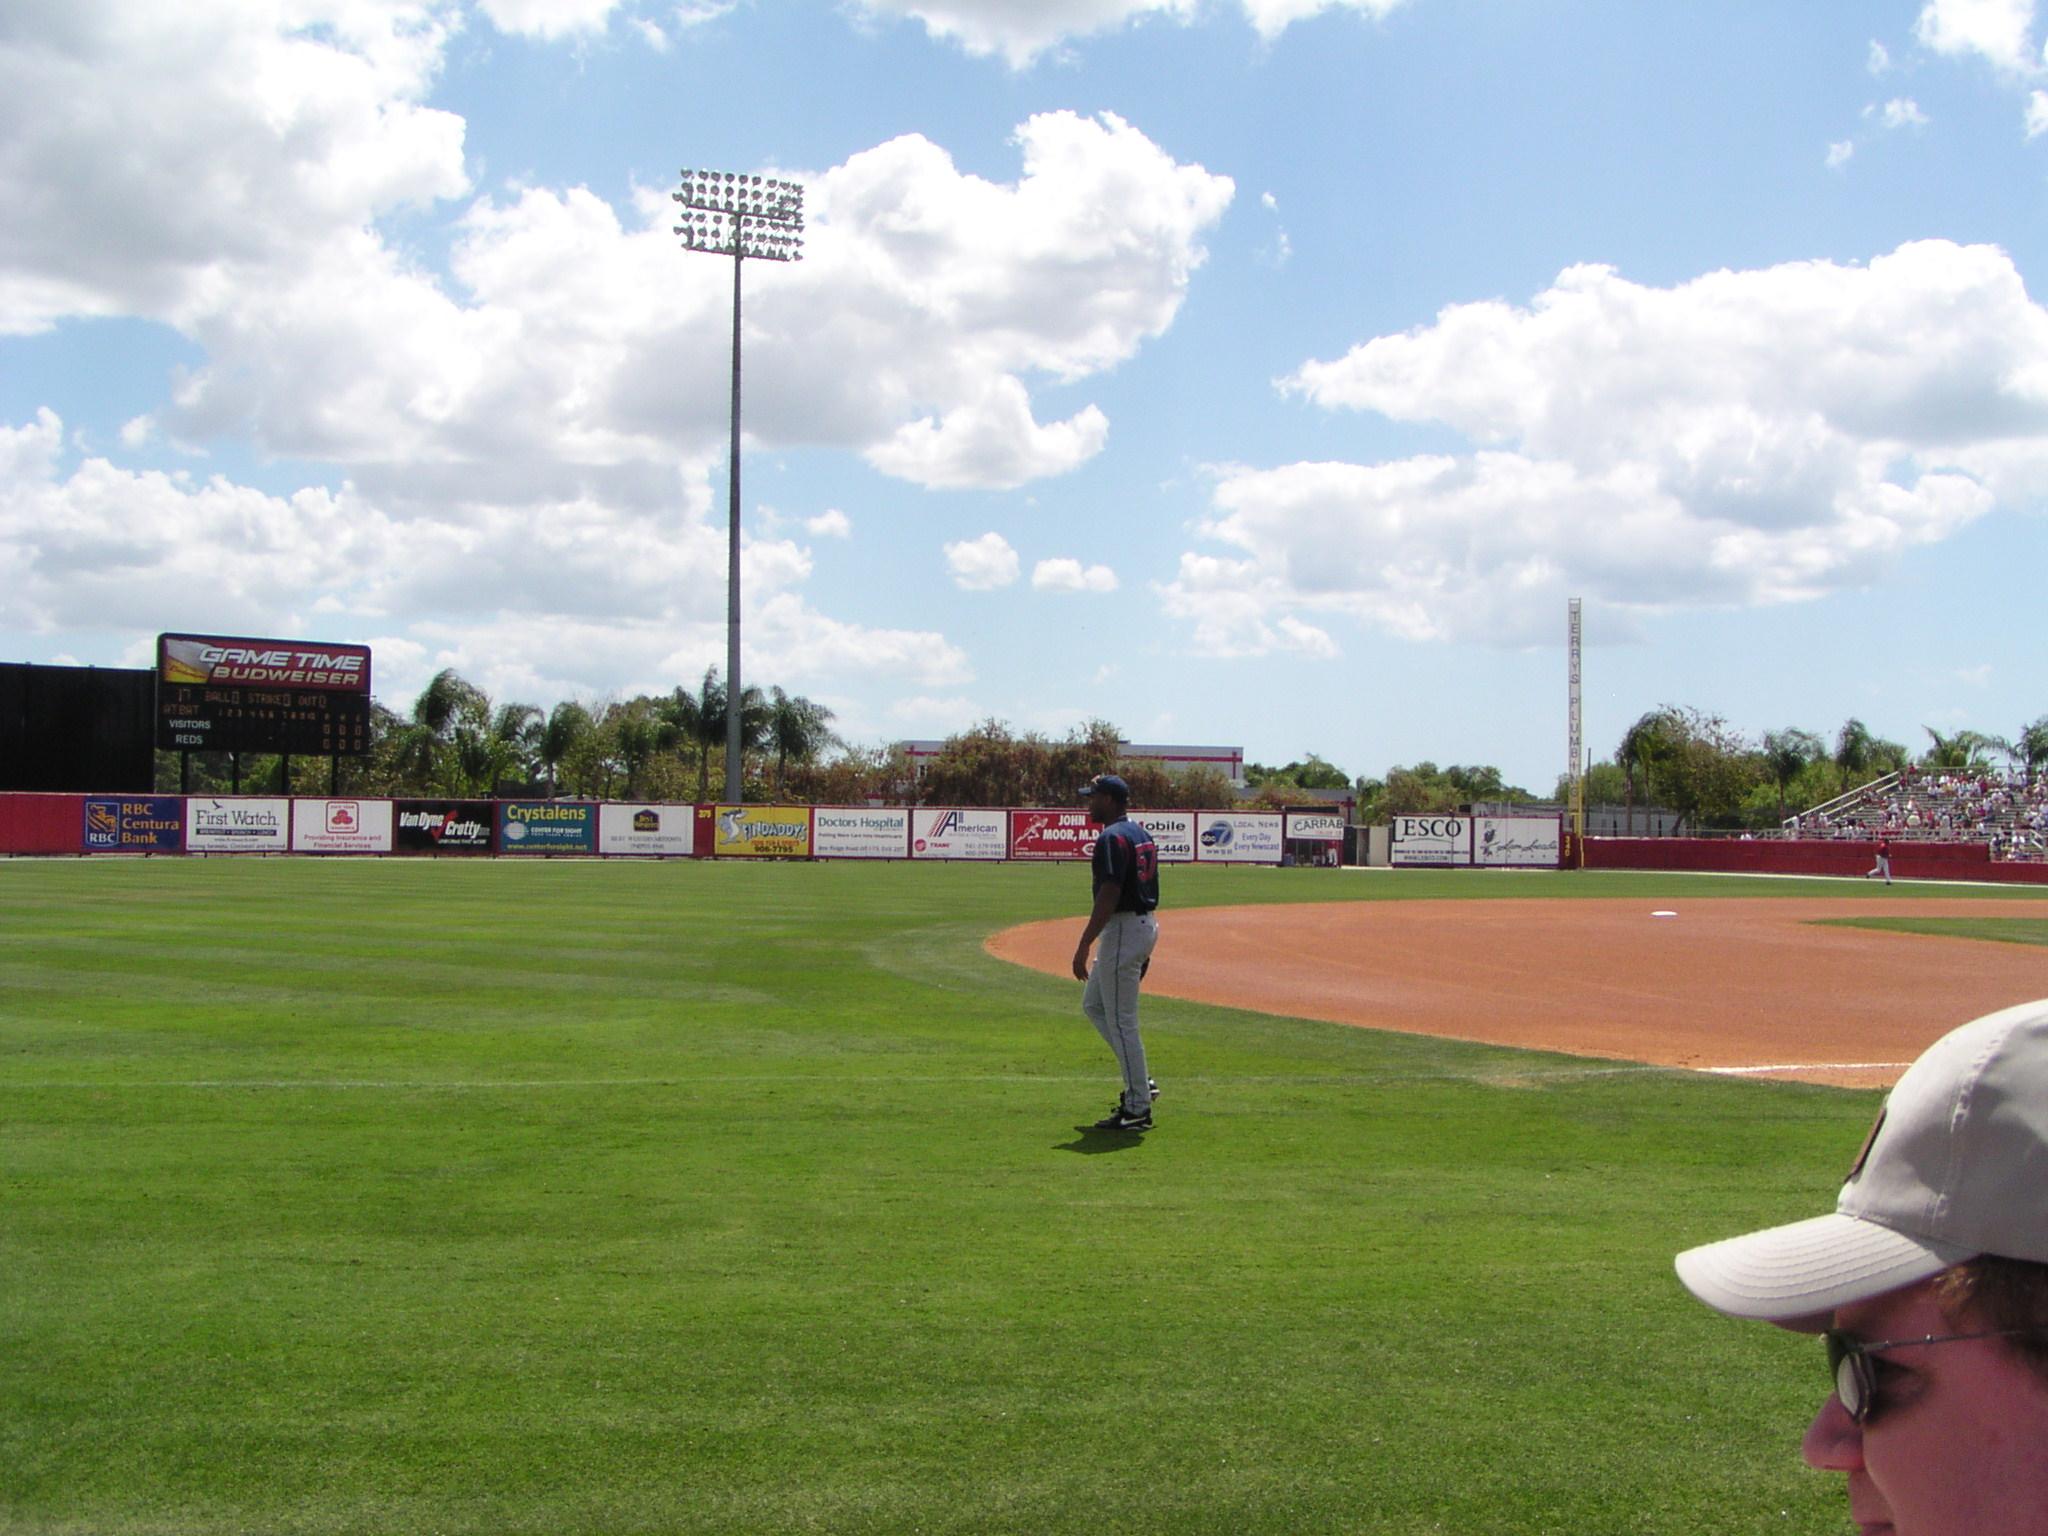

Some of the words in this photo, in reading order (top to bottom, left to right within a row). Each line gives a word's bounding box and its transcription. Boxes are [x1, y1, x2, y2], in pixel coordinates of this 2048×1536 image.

[200, 646, 289, 667] GAME
[294, 652, 364, 671] TIME
[212, 666, 359, 685] BUDWEISER
[169, 719, 211, 729] VISITORS
[175, 734, 203, 745] REDS
[122, 803, 153, 816] RBC
[507, 804, 586, 823] Crystalens
[122, 818, 180, 830] Centura
[195, 810, 229, 826] First
[399, 812, 418, 827] Van
[419, 812, 445, 830] Dyne
[818, 817, 857, 828] Doctors
[861, 817, 904, 831] Hospital
[1058, 815, 1086, 826] JOHN
[445, 820, 481, 839] Crotty
[1042, 828, 1077, 843] MOOR,
[1392, 818, 1462, 843] LESCO
[89, 832, 115, 844] RBC
[122, 832, 158, 844] Bank
